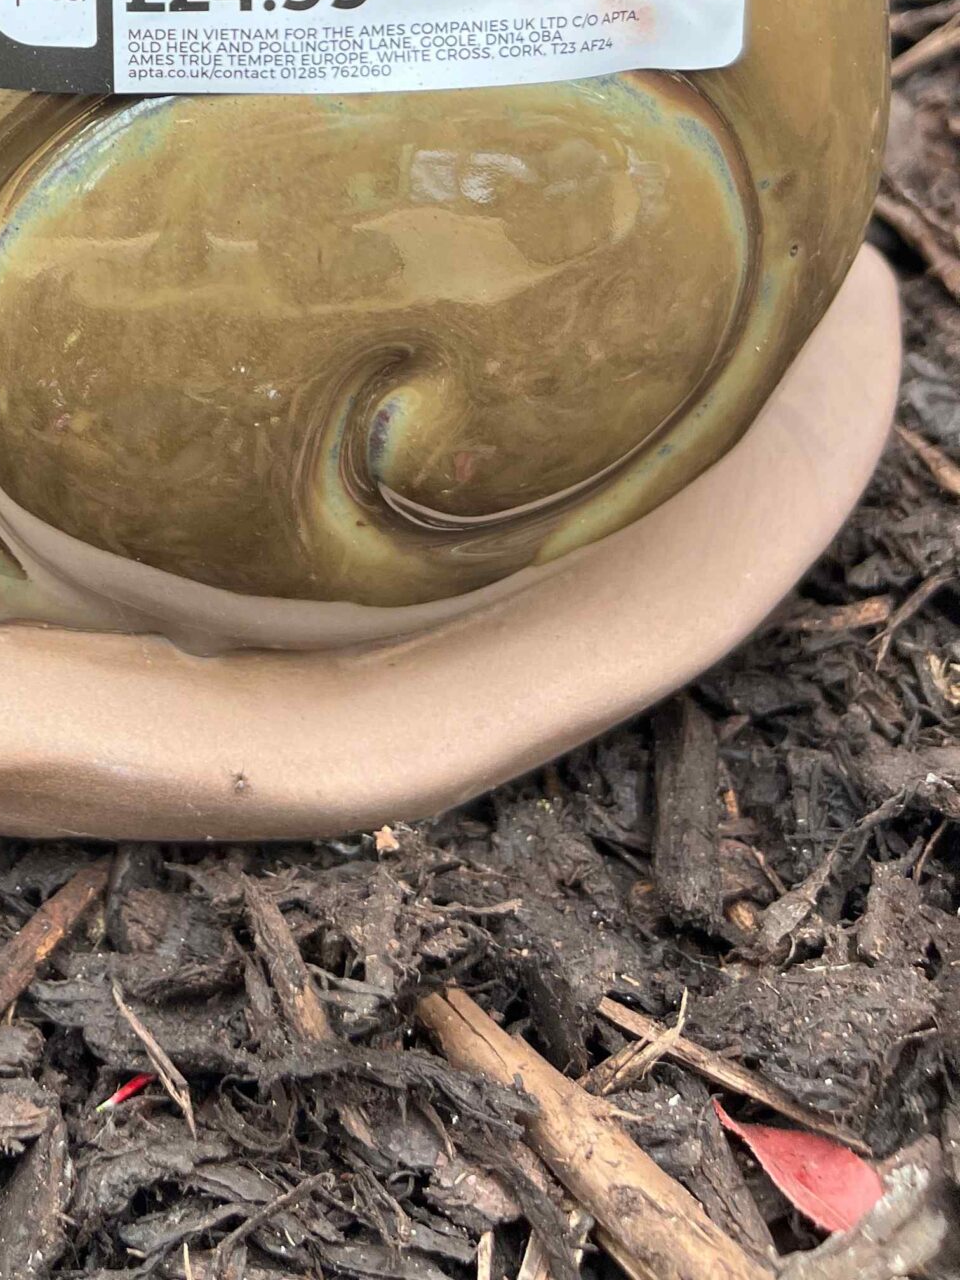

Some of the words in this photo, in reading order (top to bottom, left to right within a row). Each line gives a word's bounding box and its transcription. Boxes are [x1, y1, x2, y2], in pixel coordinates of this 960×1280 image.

[128, 28, 177, 41] MADE
[181, 28, 199, 41] IN
[203, 28, 279, 41] VIETNAM
[284, 27, 318, 40] FOR
[323, 25, 355, 39] THE
[359, 23, 406, 37] AMES
[410, 19, 509, 36] COMPANIES
[513, 19, 535, 31] UK
[540, 16, 568, 30] LTD
[572, 13, 599, 29] C/O
[128, 41, 162, 54] OLD
[166, 41, 212, 54] HECK
[216, 41, 254, 54] AND
[259, 38, 364, 54] POLLINGTON
[485, 32, 525, 46] DN14
[128, 54, 175, 67] AMES
[179, 54, 223, 67] TRUE
[227, 53, 295, 67] TEMPER
[377, 48, 431, 63] WHITE
[551, 41, 577, 55] T23
[580, 37, 614, 53] AF24
[128, 66, 277, 81] apta.co.uk/contact
[280, 65, 327, 79] 01285
[330, 64, 392, 78] 762060
